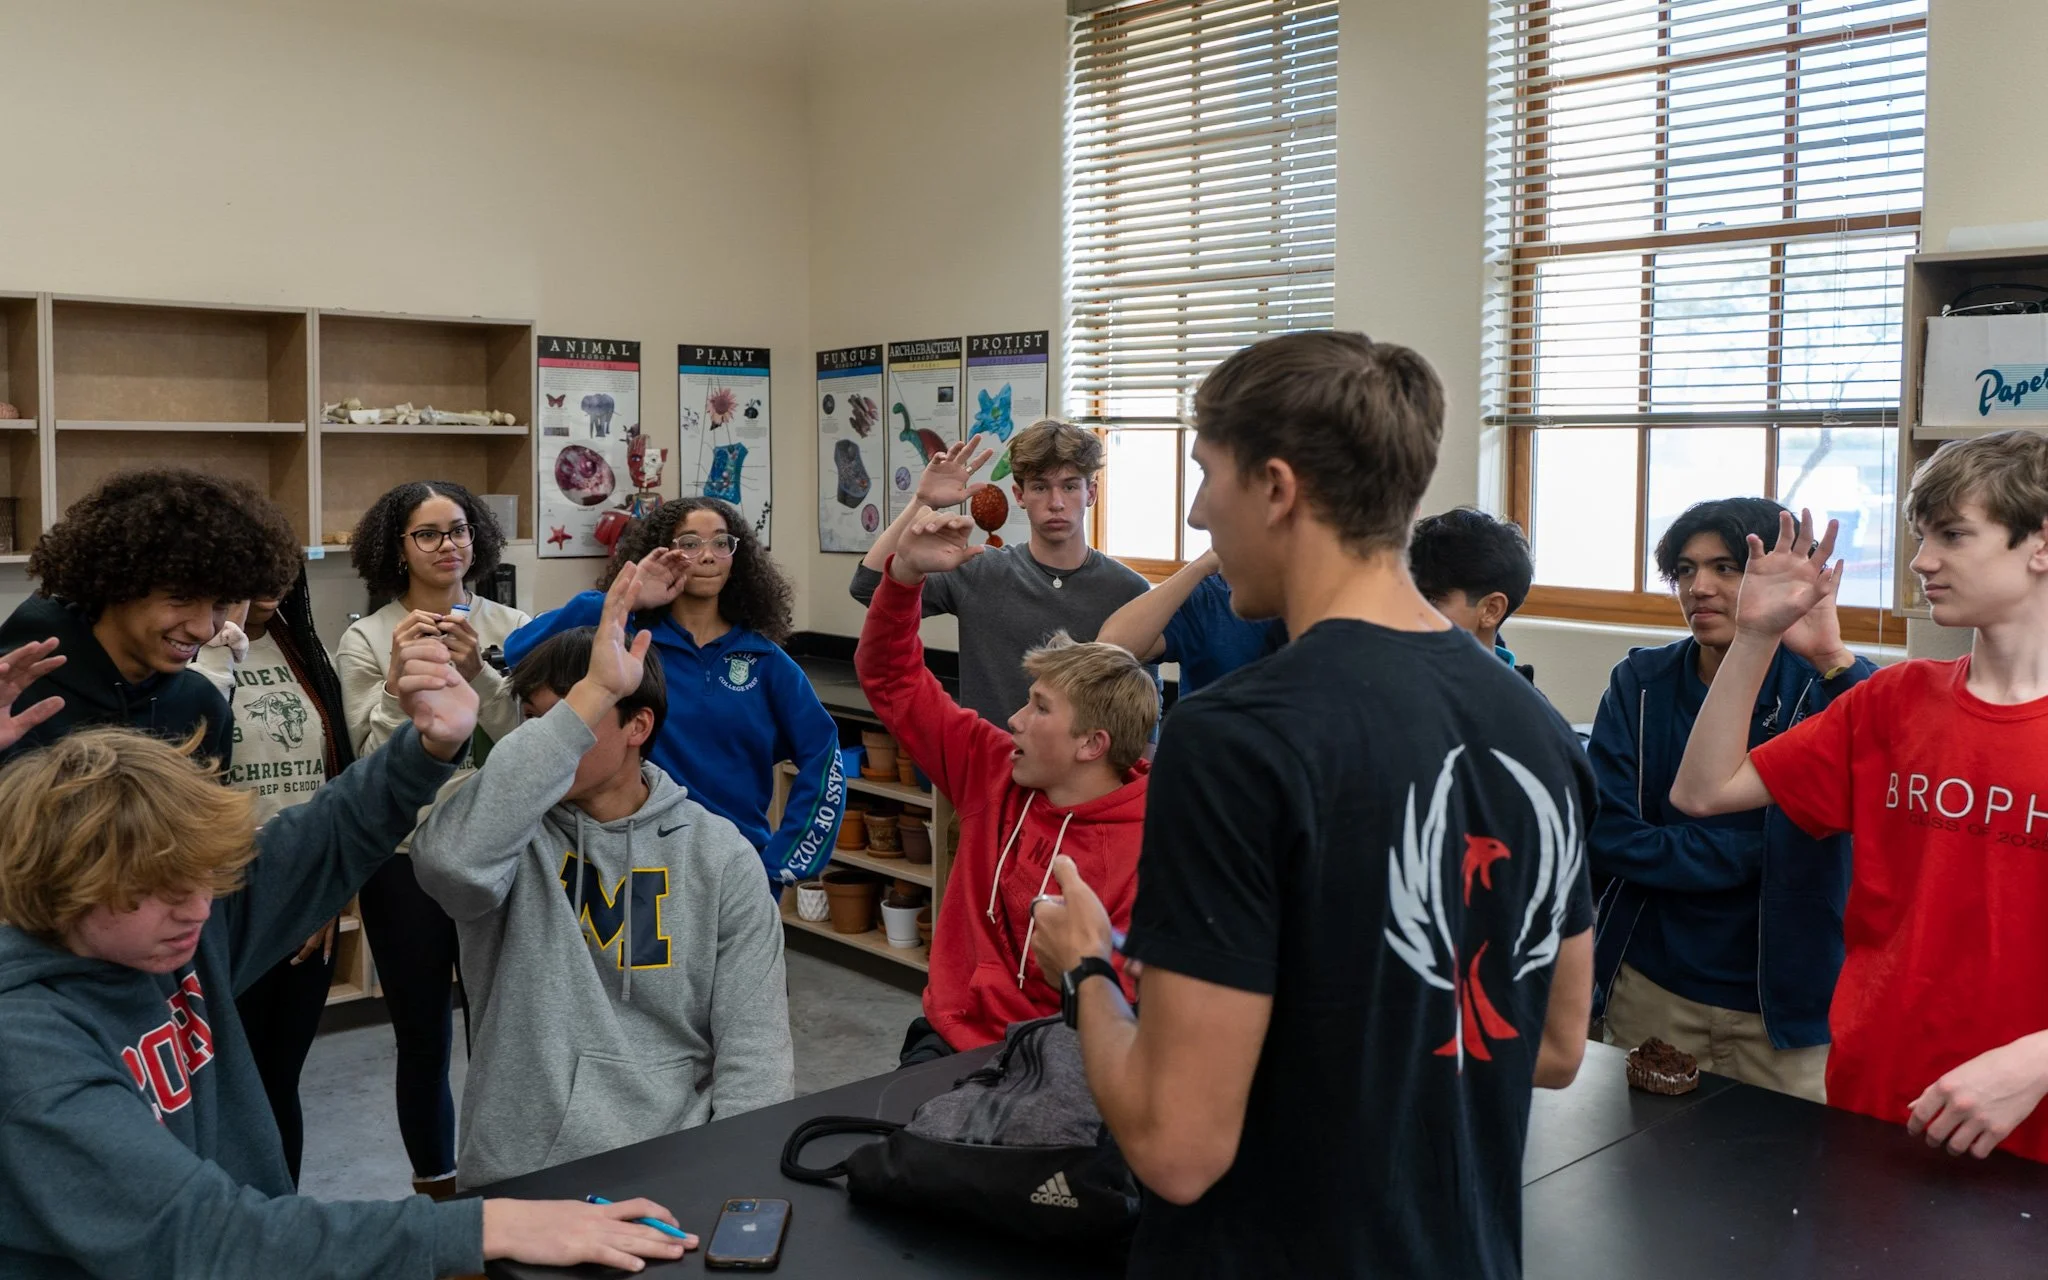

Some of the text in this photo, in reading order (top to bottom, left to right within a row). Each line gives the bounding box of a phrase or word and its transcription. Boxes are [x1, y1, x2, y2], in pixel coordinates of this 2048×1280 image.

[550, 340, 630, 356] ANIMAL
[888, 340, 961, 357] ARCHAEBACTERIA
[972, 334, 1043, 351] PROTIST
[569, 353, 612, 361] KINGDOM
[696, 348, 755, 362] PLANT
[823, 347, 877, 365] FUNGUS
[254, 783, 279, 797] REP
[788, 749, 844, 871] CLASS OF 2025
[559, 851, 672, 970] M
[1030, 1192, 1079, 1208] adidas
